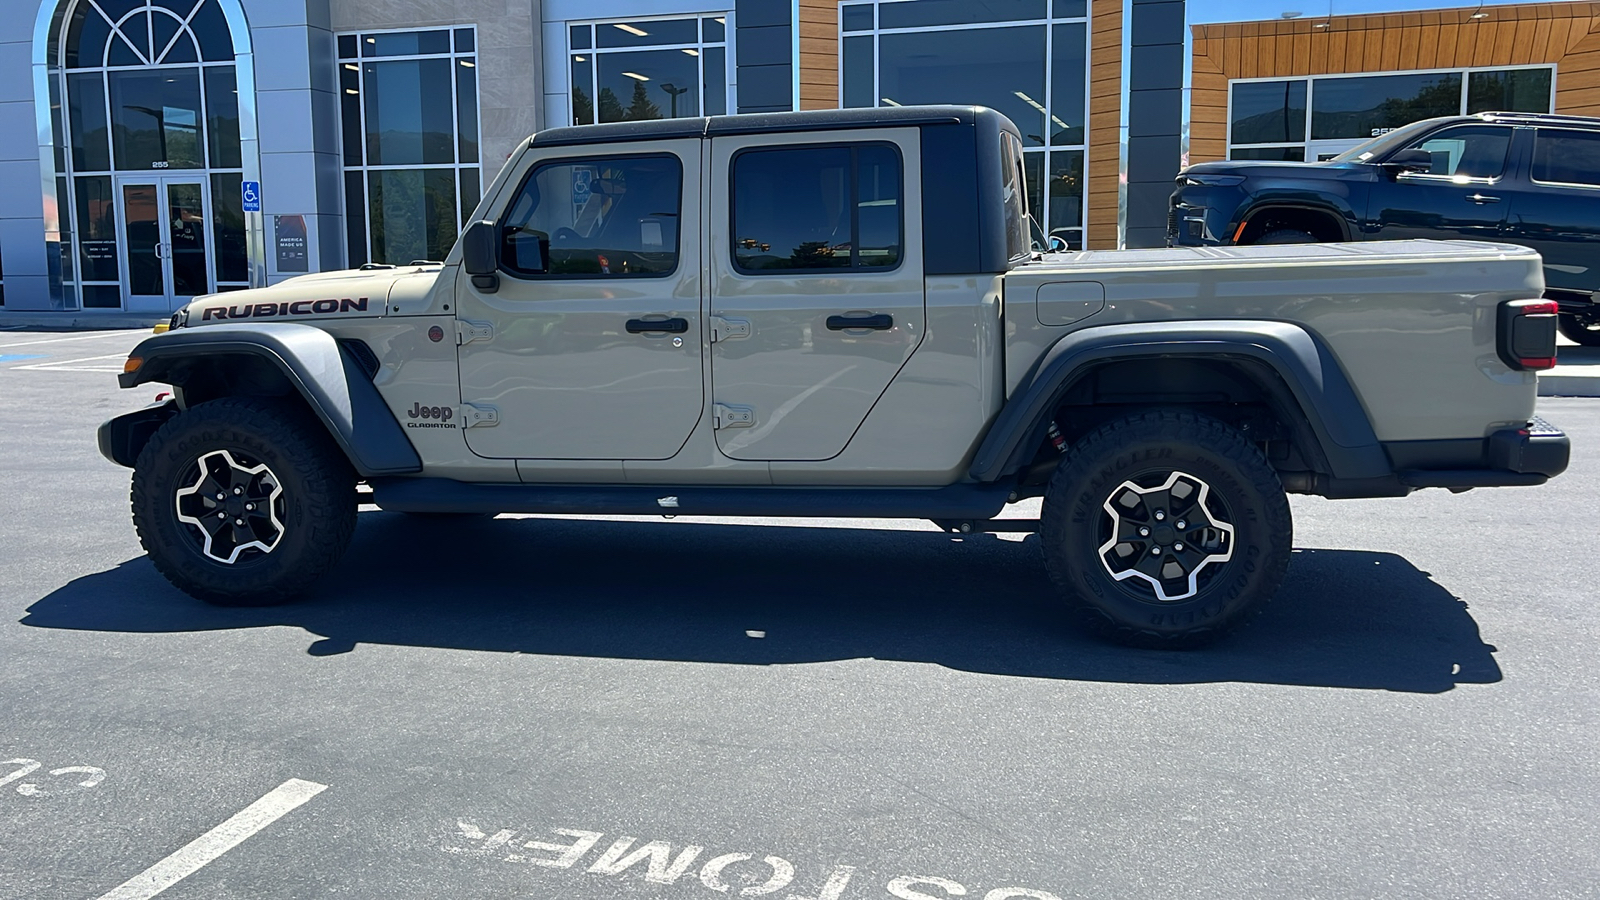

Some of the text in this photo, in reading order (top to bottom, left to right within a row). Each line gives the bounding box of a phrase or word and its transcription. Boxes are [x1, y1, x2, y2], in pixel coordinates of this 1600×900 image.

[202, 297, 368, 321] RUBICON
[408, 402, 453, 422] Jeep
[1072, 447, 1173, 524] WRANGLER
